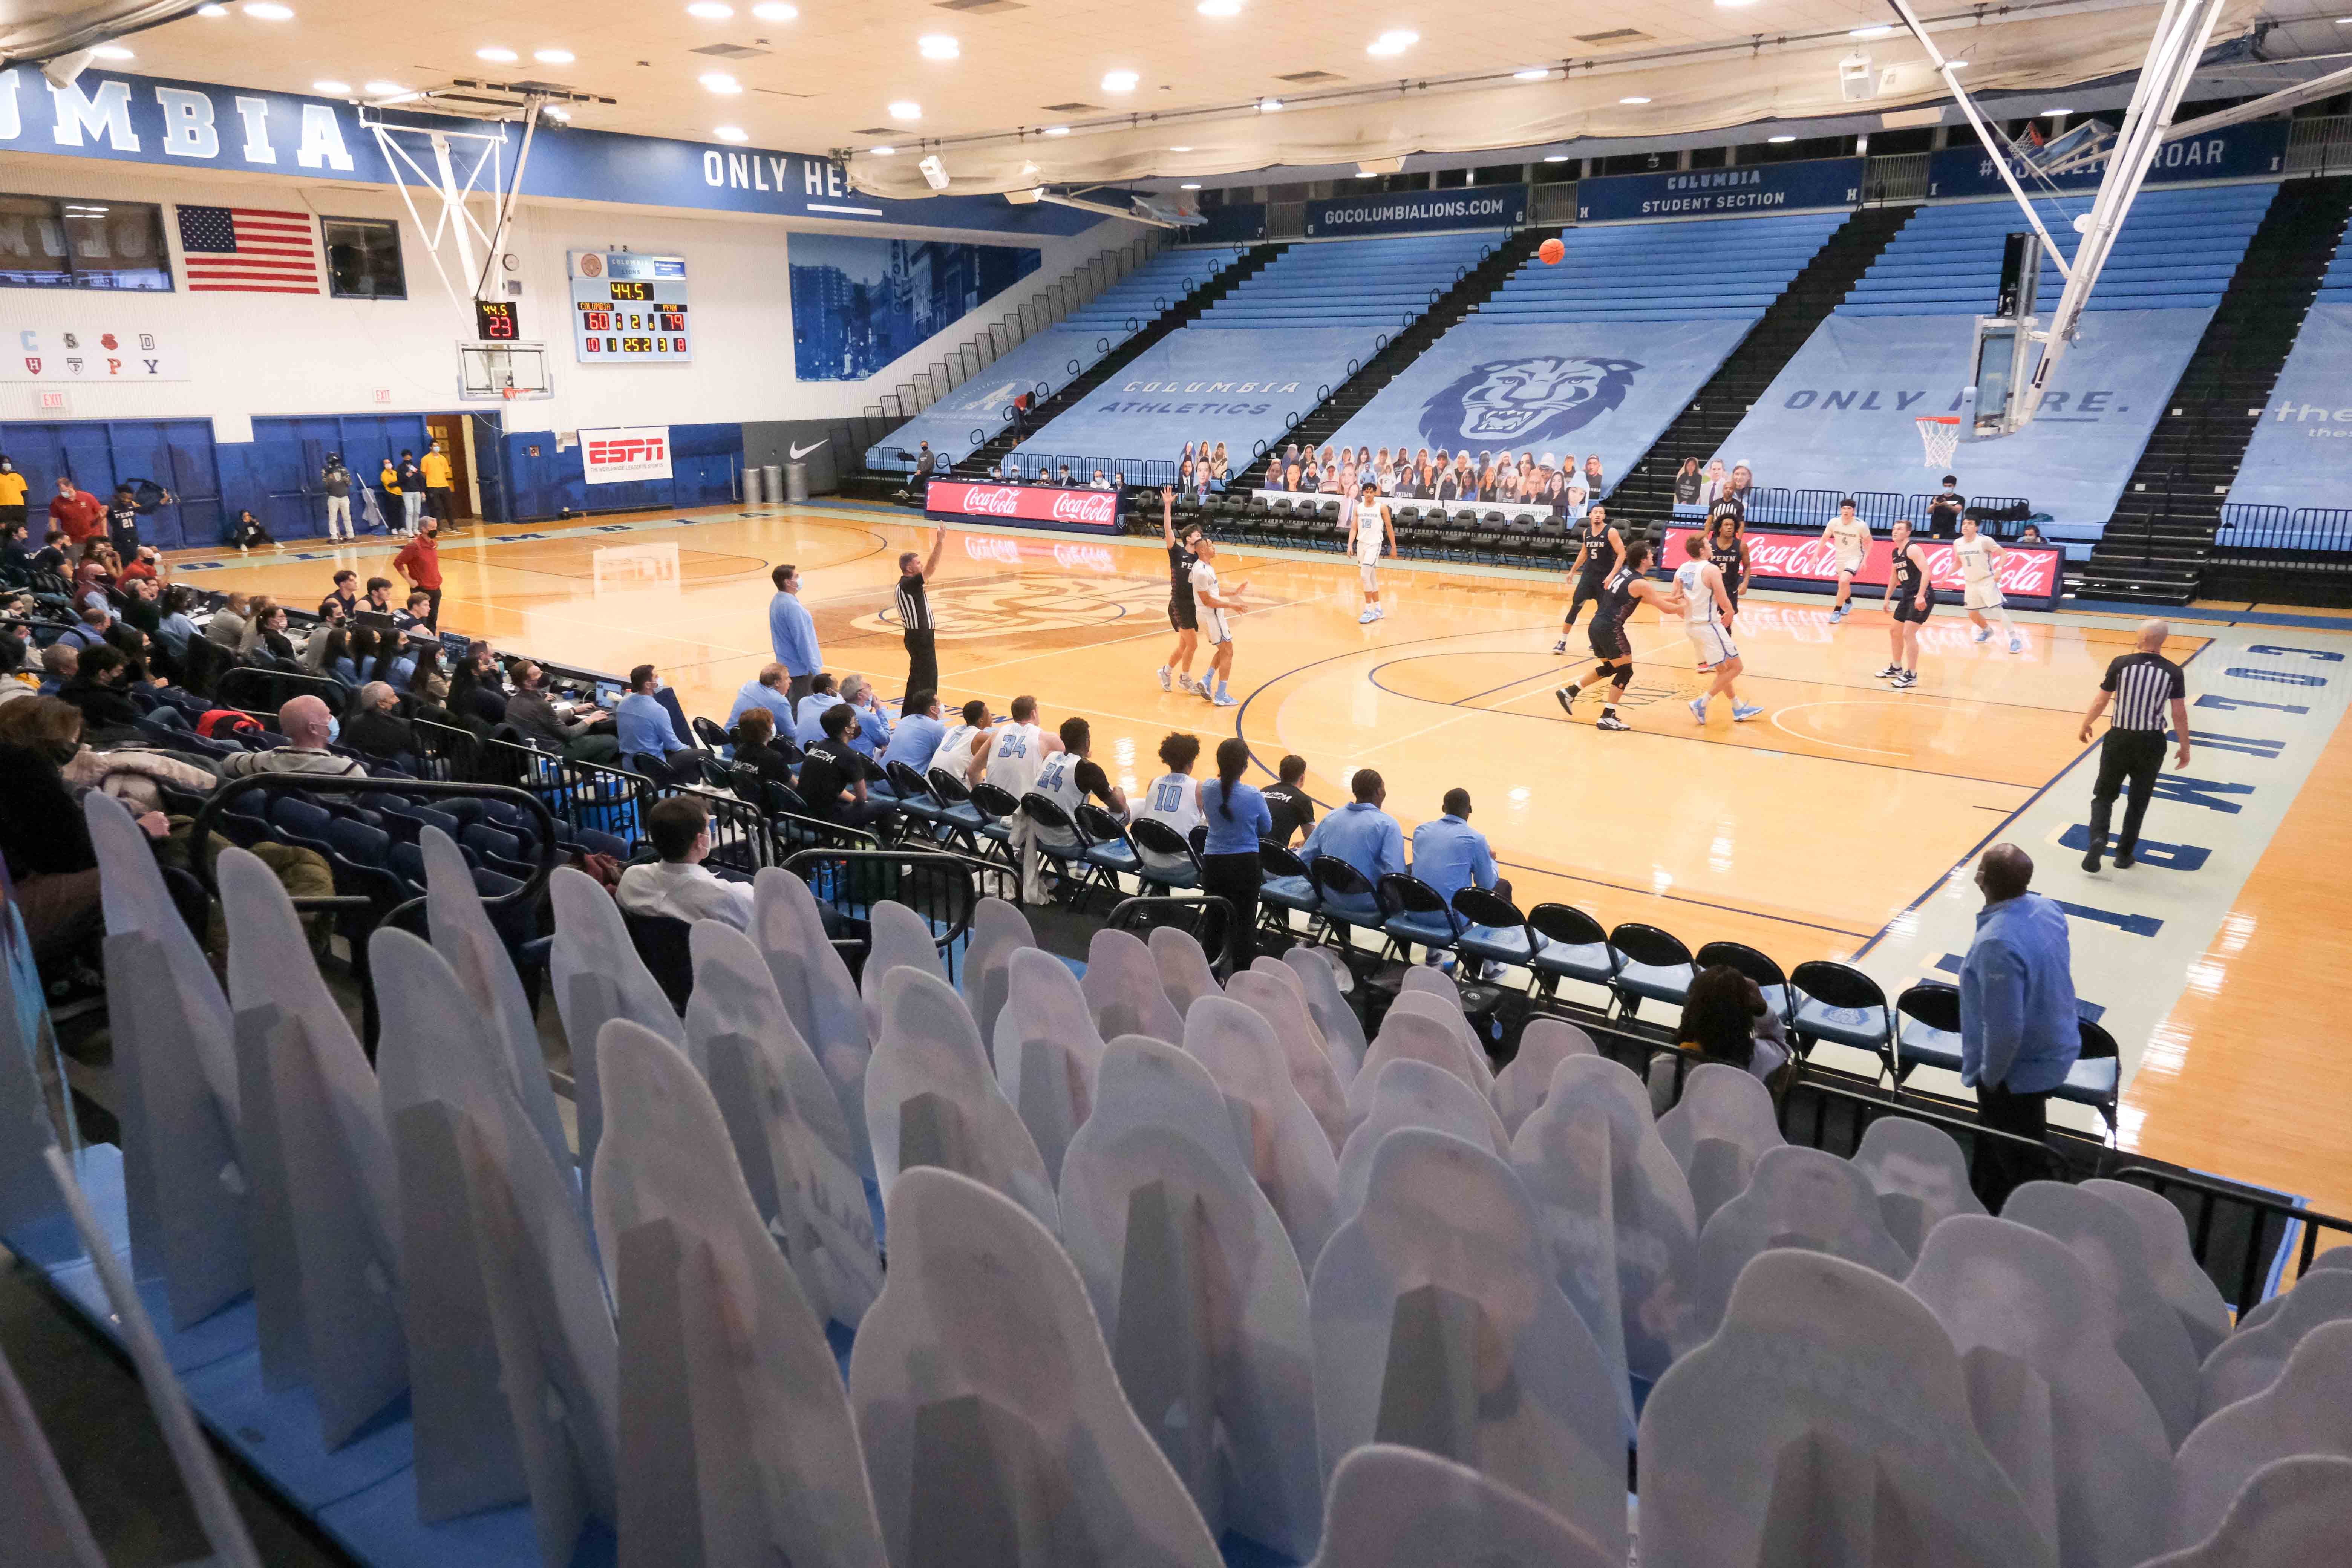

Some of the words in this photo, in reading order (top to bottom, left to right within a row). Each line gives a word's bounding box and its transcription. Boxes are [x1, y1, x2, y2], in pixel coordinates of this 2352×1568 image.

[0, 69, 354, 171] MBIA
[703, 150, 787, 192] ONLY
[1668, 170, 1760, 190] COLUMBIA
[1642, 197, 1712, 212] STUDENT
[1717, 191, 1785, 209] SECTION
[1325, 199, 1503, 224] GOCOLUMBIALIONS.COM
[611, 283, 644, 300] 44.5
[483, 305, 507, 316] 44.5
[580, 303, 611, 311] COLUMBIA
[490, 317, 511, 337] 23
[588, 312, 609, 330] 60
[632, 315, 639, 329] 2
[666, 314, 684, 330] 79
[139, 334, 155, 350] D
[587, 338, 599, 351] 10
[612, 339, 616, 351] 1
[660, 338, 666, 351] 3
[677, 338, 685, 351] 8
[143, 360, 158, 374] Y
[376, 389, 390, 400] EXIT
[1122, 381, 1300, 393] COLUMBIA
[43, 394, 63, 407] EXIT
[1098, 402, 1272, 414] ATHLETICS
[1783, 390, 1926, 411] ONLY
[589, 438, 663, 464] ESPN
[963, 486, 1022, 514] Coca-Cola
[1053, 492, 1116, 522] Coca-Cola
[122, 518, 134, 528] 21
[1591, 549, 1598, 559] 5
[1181, 561, 1193, 570] PE
[1719, 563, 1727, 574] 3
[1607, 574, 1626, 594] 14
[998, 735, 1026, 758] 34
[1037, 762, 1064, 793] 24
[1154, 784, 1182, 812] 10
